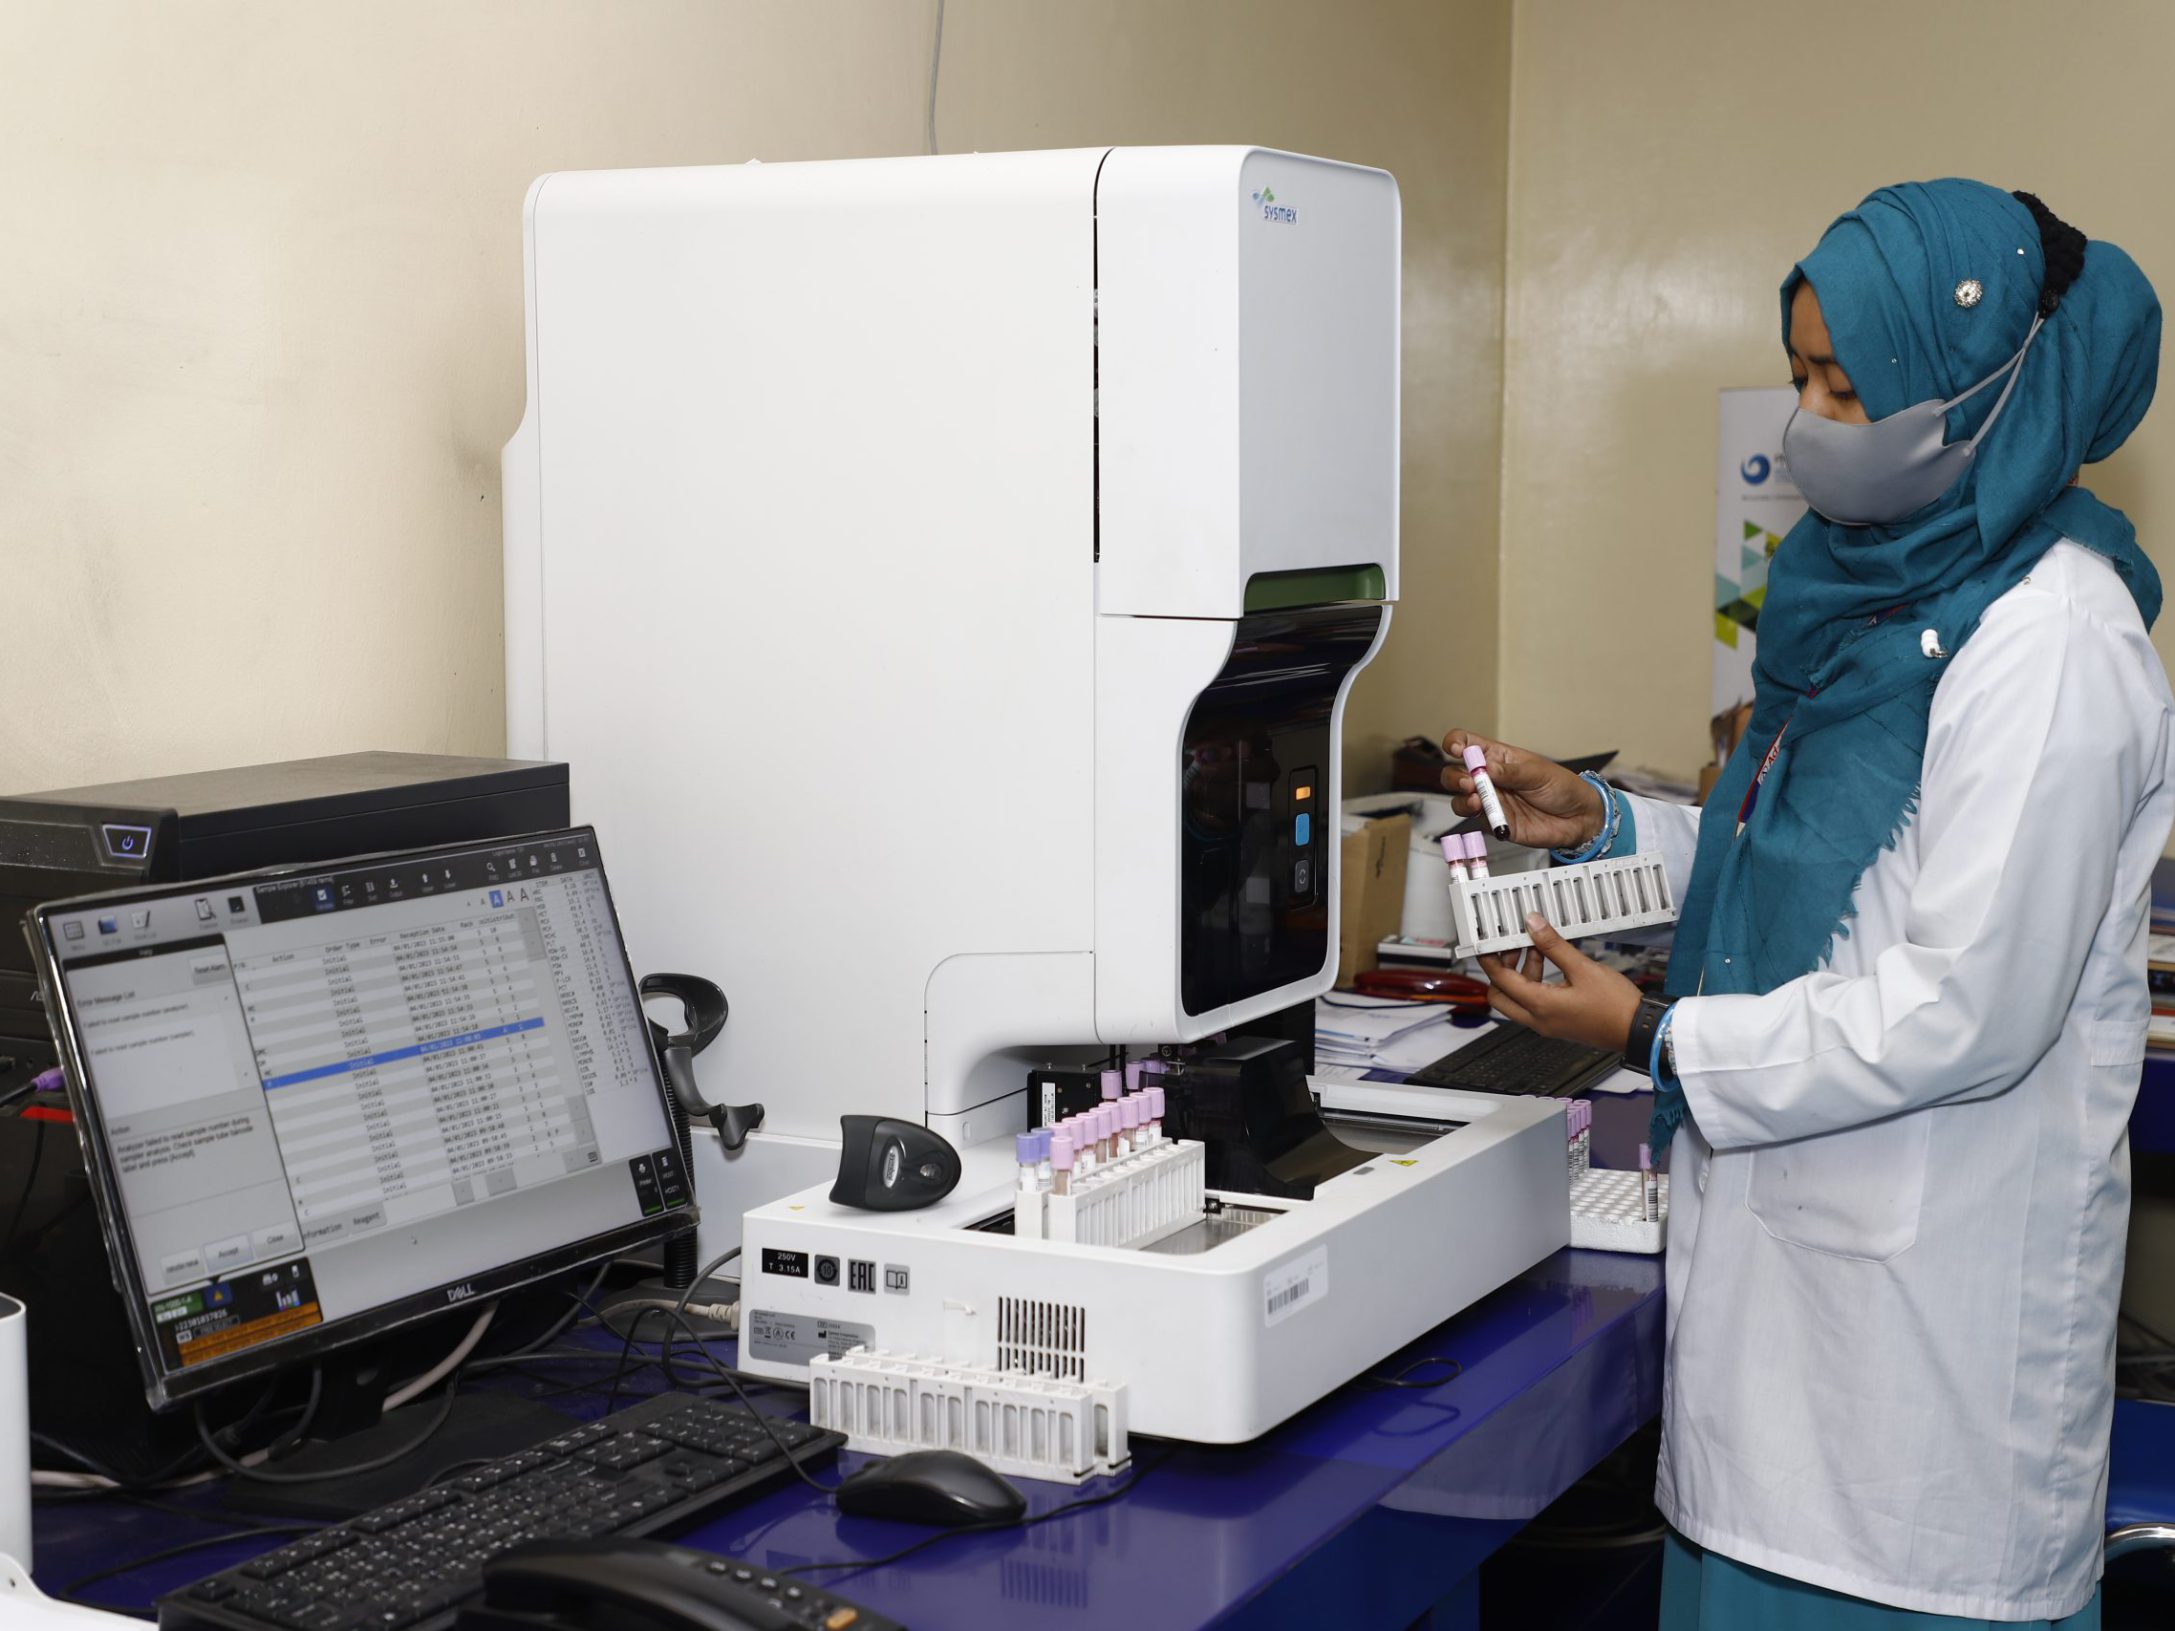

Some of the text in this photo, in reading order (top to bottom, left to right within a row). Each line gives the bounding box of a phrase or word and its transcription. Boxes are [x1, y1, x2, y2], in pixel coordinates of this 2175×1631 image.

[1264, 205, 1297, 223] sysmex
[507, 892, 516, 902] A
[520, 888, 530, 902] A
[145, 1137, 162, 1147] failed
[170, 1132, 184, 1141] read
[186, 1127, 206, 1137] sample
[208, 1121, 229, 1131] number
[230, 1116, 251, 1127] during
[352, 1211, 381, 1227] Reagent
[217, 1246, 240, 1259] Accept
[777, 1252, 796, 1262] 250V
[778, 1264, 801, 1274] 3.15A
[850, 1261, 875, 1292] EAC
[448, 1283, 475, 1300] DELL
